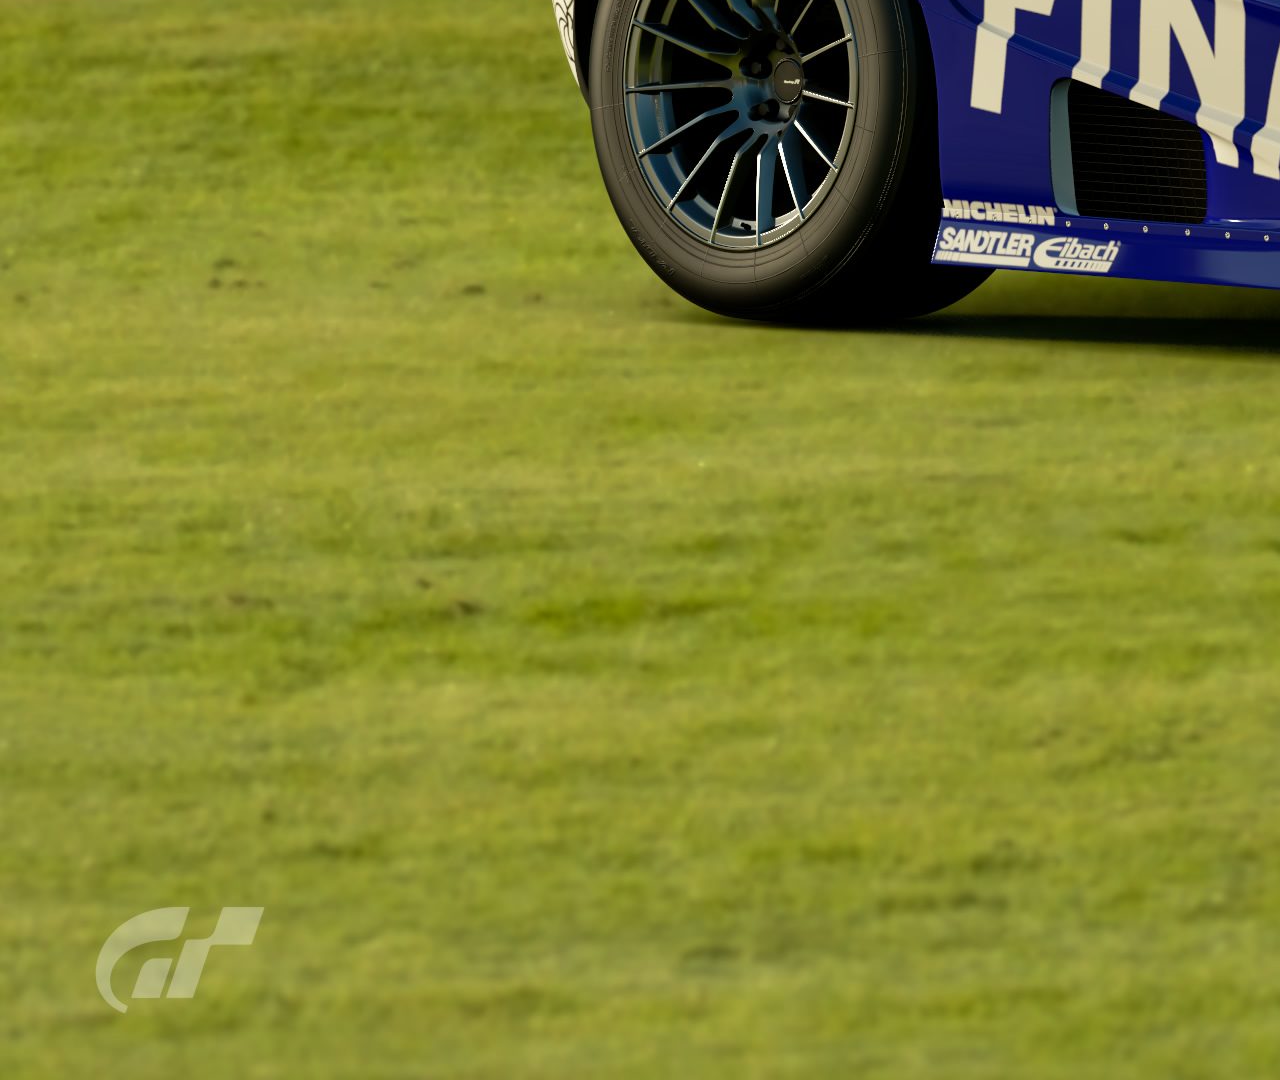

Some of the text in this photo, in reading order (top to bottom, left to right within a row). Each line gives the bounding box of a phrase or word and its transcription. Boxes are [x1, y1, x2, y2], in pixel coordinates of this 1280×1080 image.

[943, 198, 1056, 226] MICHELIN
[939, 226, 1121, 272] SANDTLER Eibach
